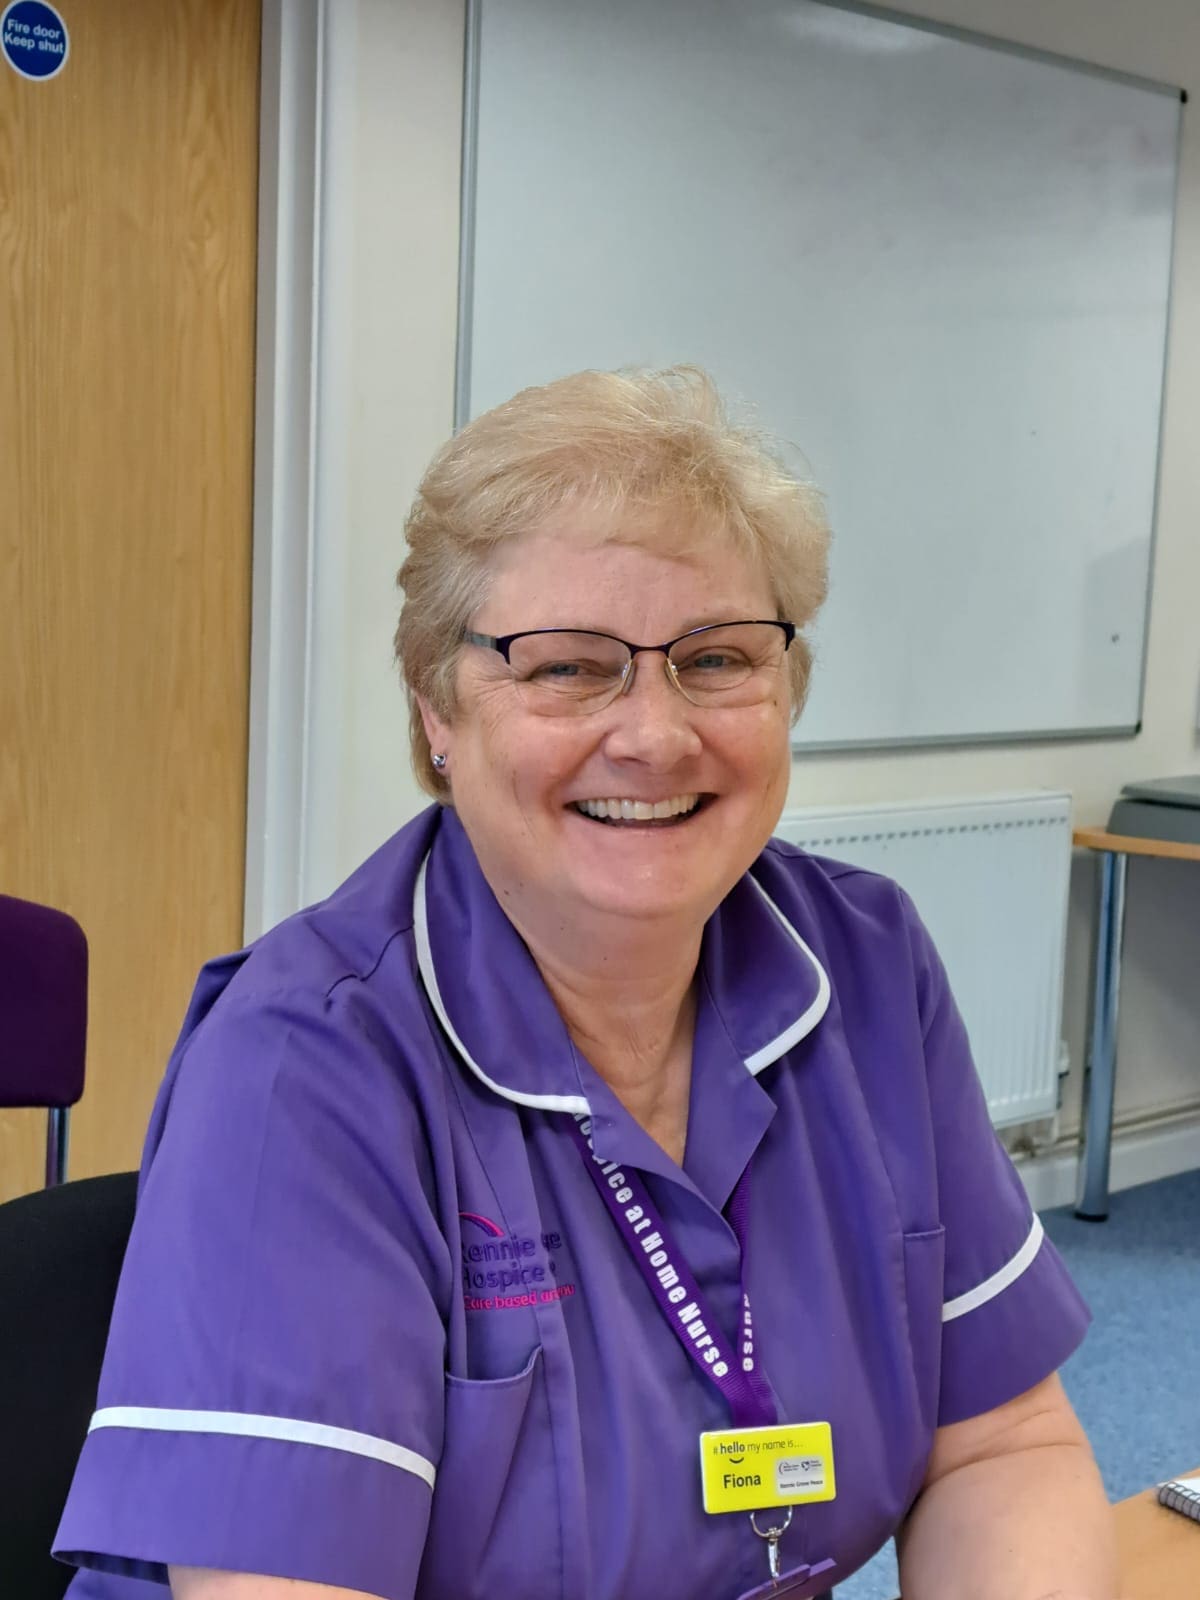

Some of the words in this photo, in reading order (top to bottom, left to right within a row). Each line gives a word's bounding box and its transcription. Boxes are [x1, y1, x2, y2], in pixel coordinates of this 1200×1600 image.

[7, 19, 30, 33] Fire
[33, 24, 61, 39] door
[4, 32, 36, 51] Keep
[38, 39, 63, 54] shut
[494, 1290, 538, 1309] based
[625, 1205, 651, 1235] at
[640, 1231, 687, 1304] Home
[677, 1302, 728, 1378] Nurse
[762, 1440, 785, 1451] name
[723, 1474, 761, 1489] Fiona
